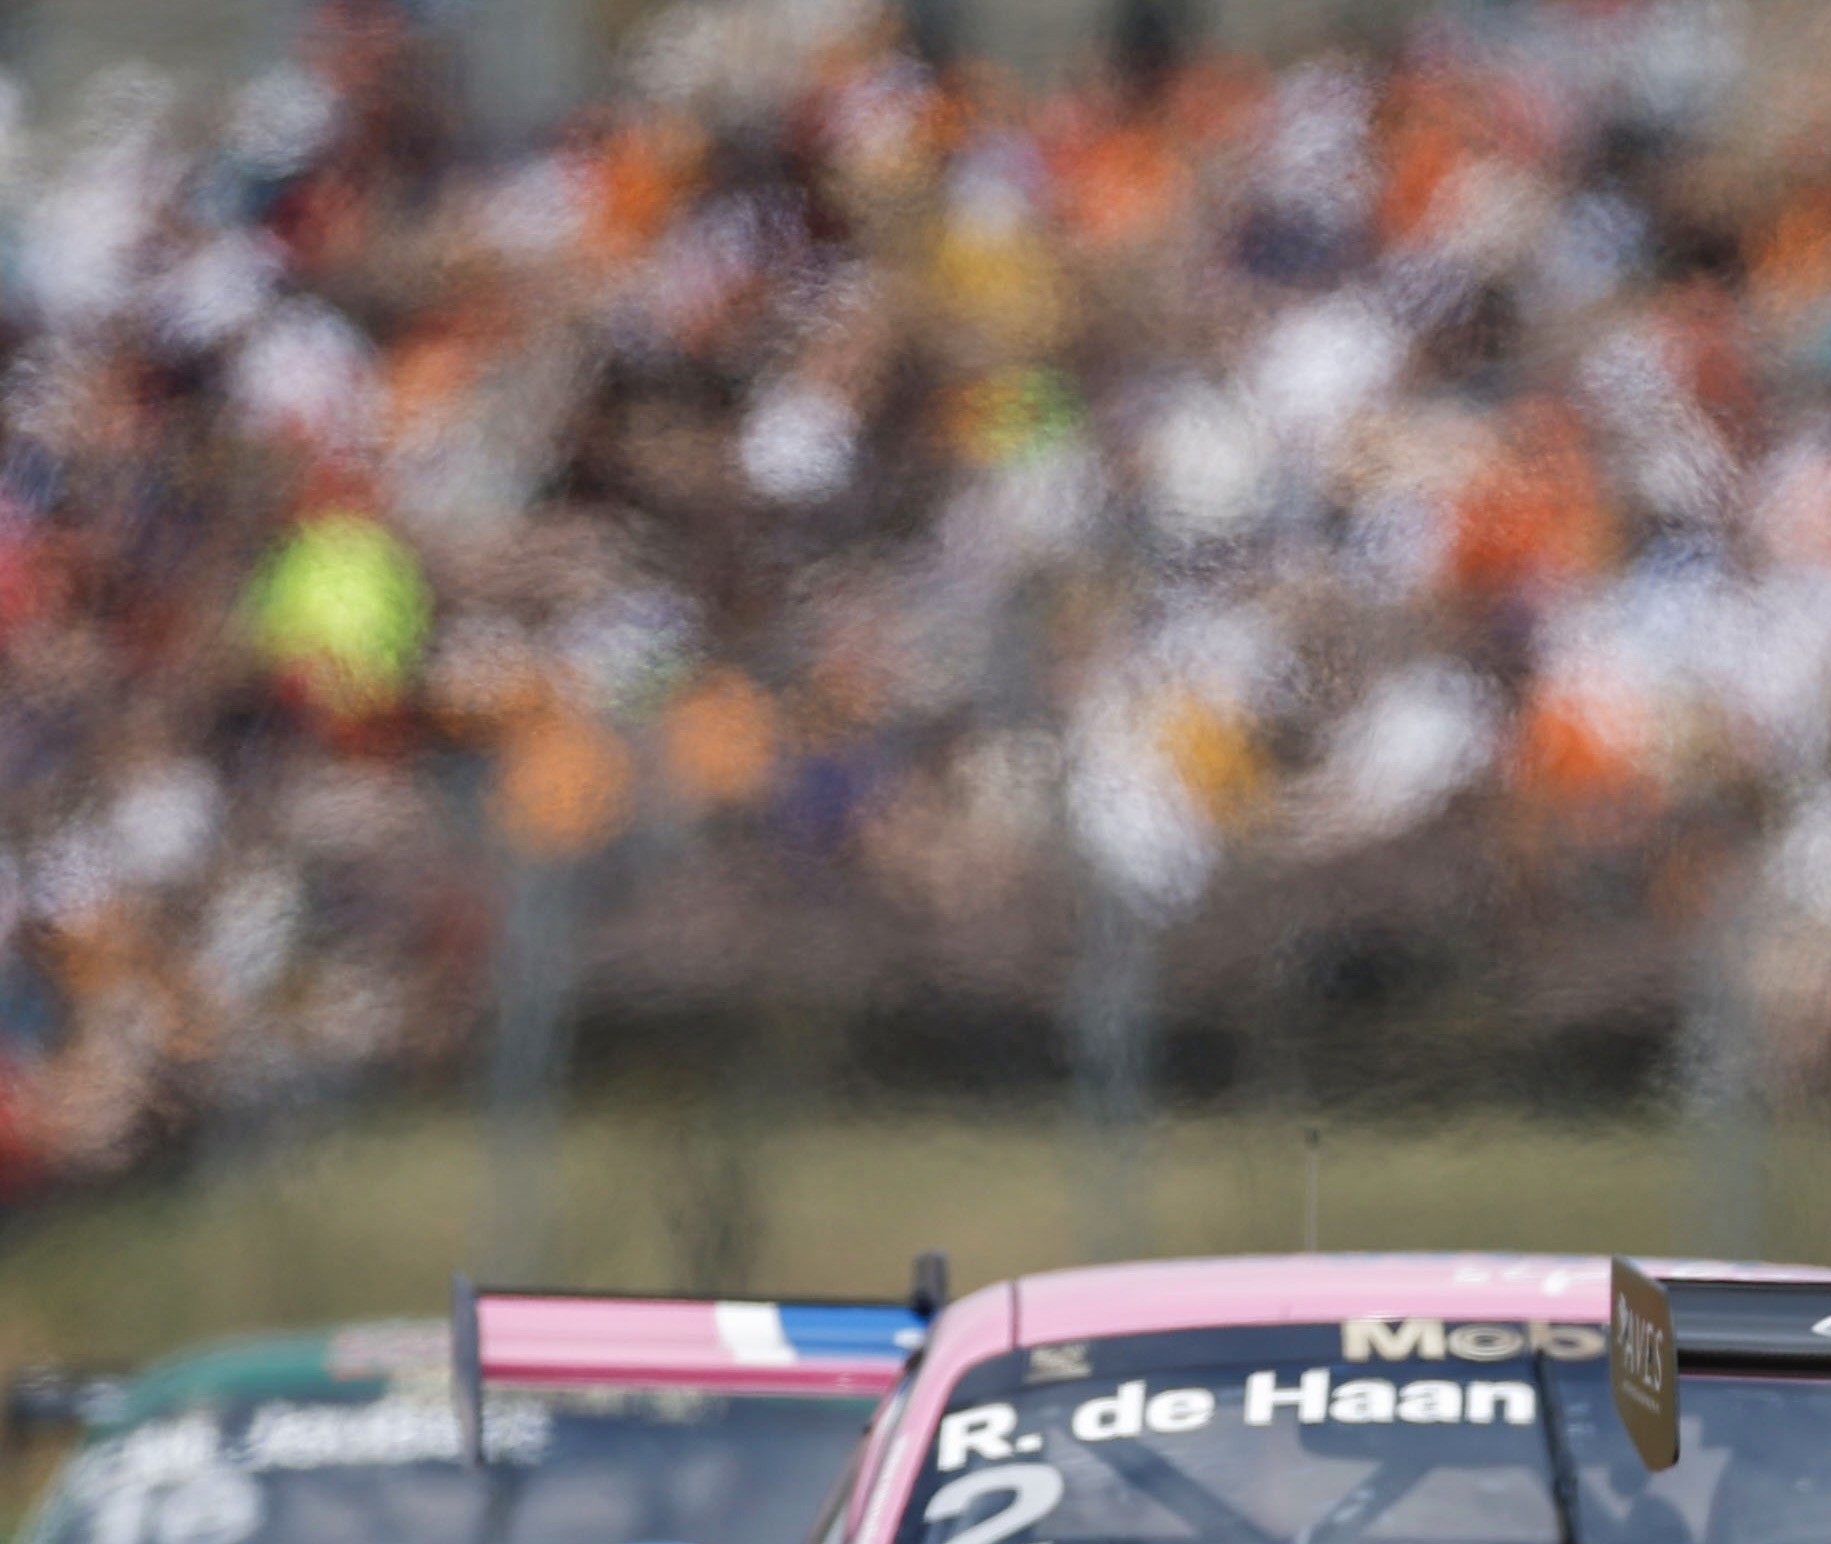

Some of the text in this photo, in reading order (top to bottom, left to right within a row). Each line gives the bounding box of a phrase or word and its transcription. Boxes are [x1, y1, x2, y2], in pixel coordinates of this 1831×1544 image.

[936, 1368, 1538, 1472] R. de Haan
